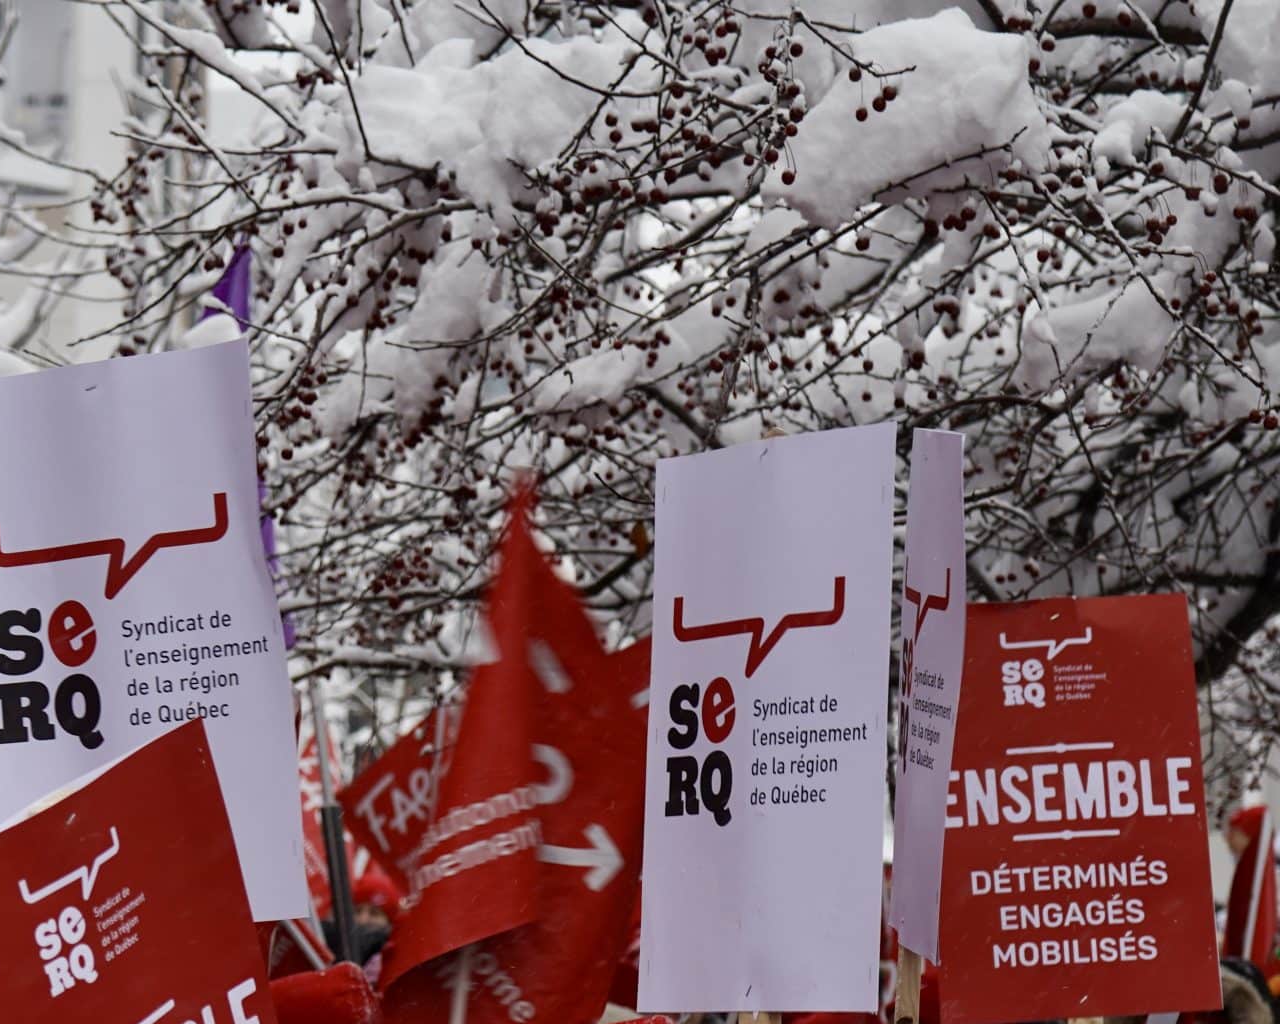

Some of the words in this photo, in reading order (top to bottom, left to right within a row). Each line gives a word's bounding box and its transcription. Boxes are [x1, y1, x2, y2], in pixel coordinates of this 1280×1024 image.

[121, 613, 205, 641] Syndicat
[210, 610, 232, 629] de
[124, 636, 269, 668] l'enseignement
[127, 678, 150, 697] de
[155, 675, 174, 694] la
[179, 670, 240, 694] région
[1003, 682, 1046, 708] RQ
[129, 708, 152, 726] de
[158, 701, 230, 724] Québec
[753, 696, 815, 721] Syndicat
[819, 694, 838, 713] de
[752, 722, 868, 749] l'enseignement
[751, 758, 768, 776] de
[772, 757, 786, 775] la
[790, 754, 839, 778] région
[665, 749, 733, 827] RQ
[750, 787, 767, 806] de
[770, 783, 827, 805] Québec
[944, 756, 1196, 829] ENSEMBLE
[970, 858, 1169, 897] DÉTERMINÉS
[1000, 898, 1145, 931] ENGAGÉS
[992, 934, 1159, 969] MOBILISÉS
[43, 943, 99, 998] RQ
